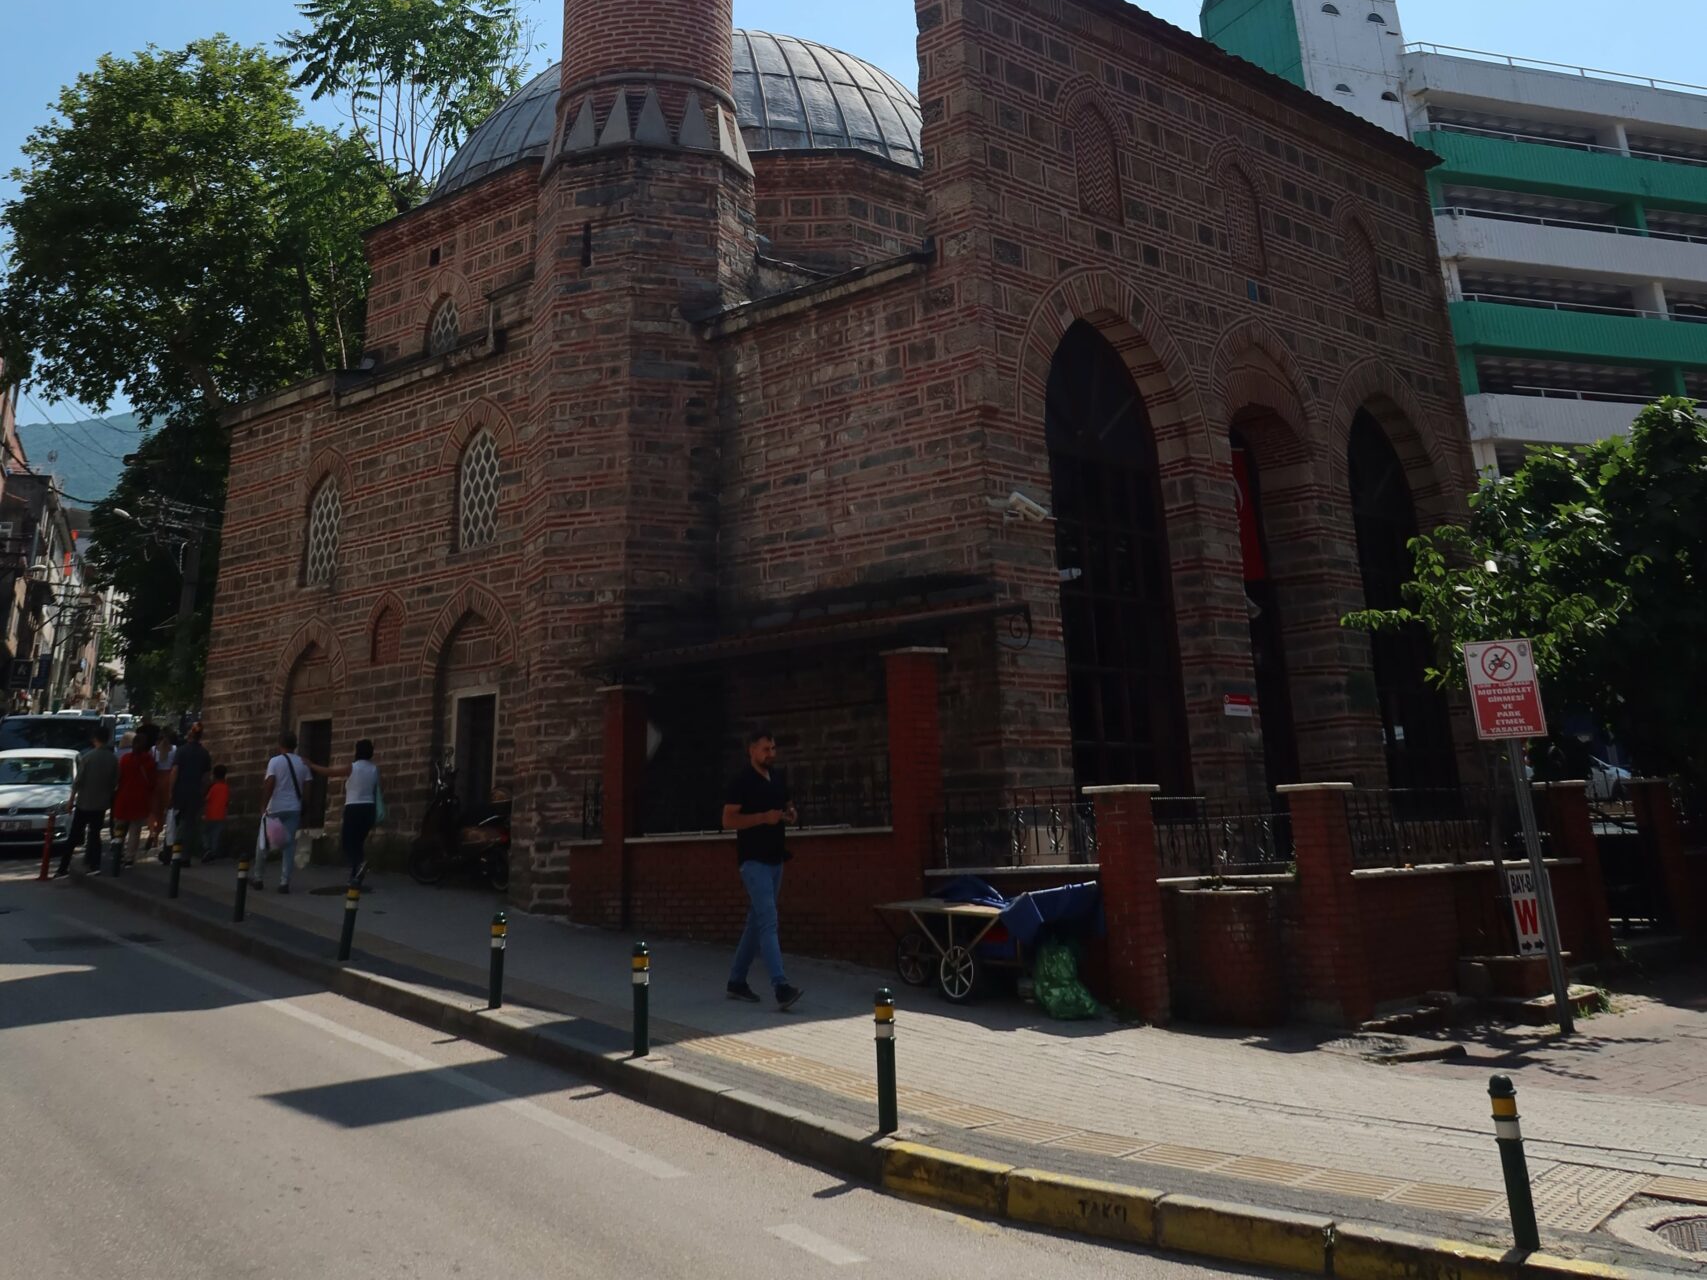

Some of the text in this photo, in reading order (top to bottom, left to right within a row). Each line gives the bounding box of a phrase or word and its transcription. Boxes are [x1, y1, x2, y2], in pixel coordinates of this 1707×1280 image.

[1477, 687, 1532, 696] MOTOSİKLET
[1488, 694, 1525, 703] GİRMESİ
[1496, 718, 1526, 726] ETMEK
[1490, 725, 1534, 733] YASAKTIR
[1514, 899, 1538, 936] W
